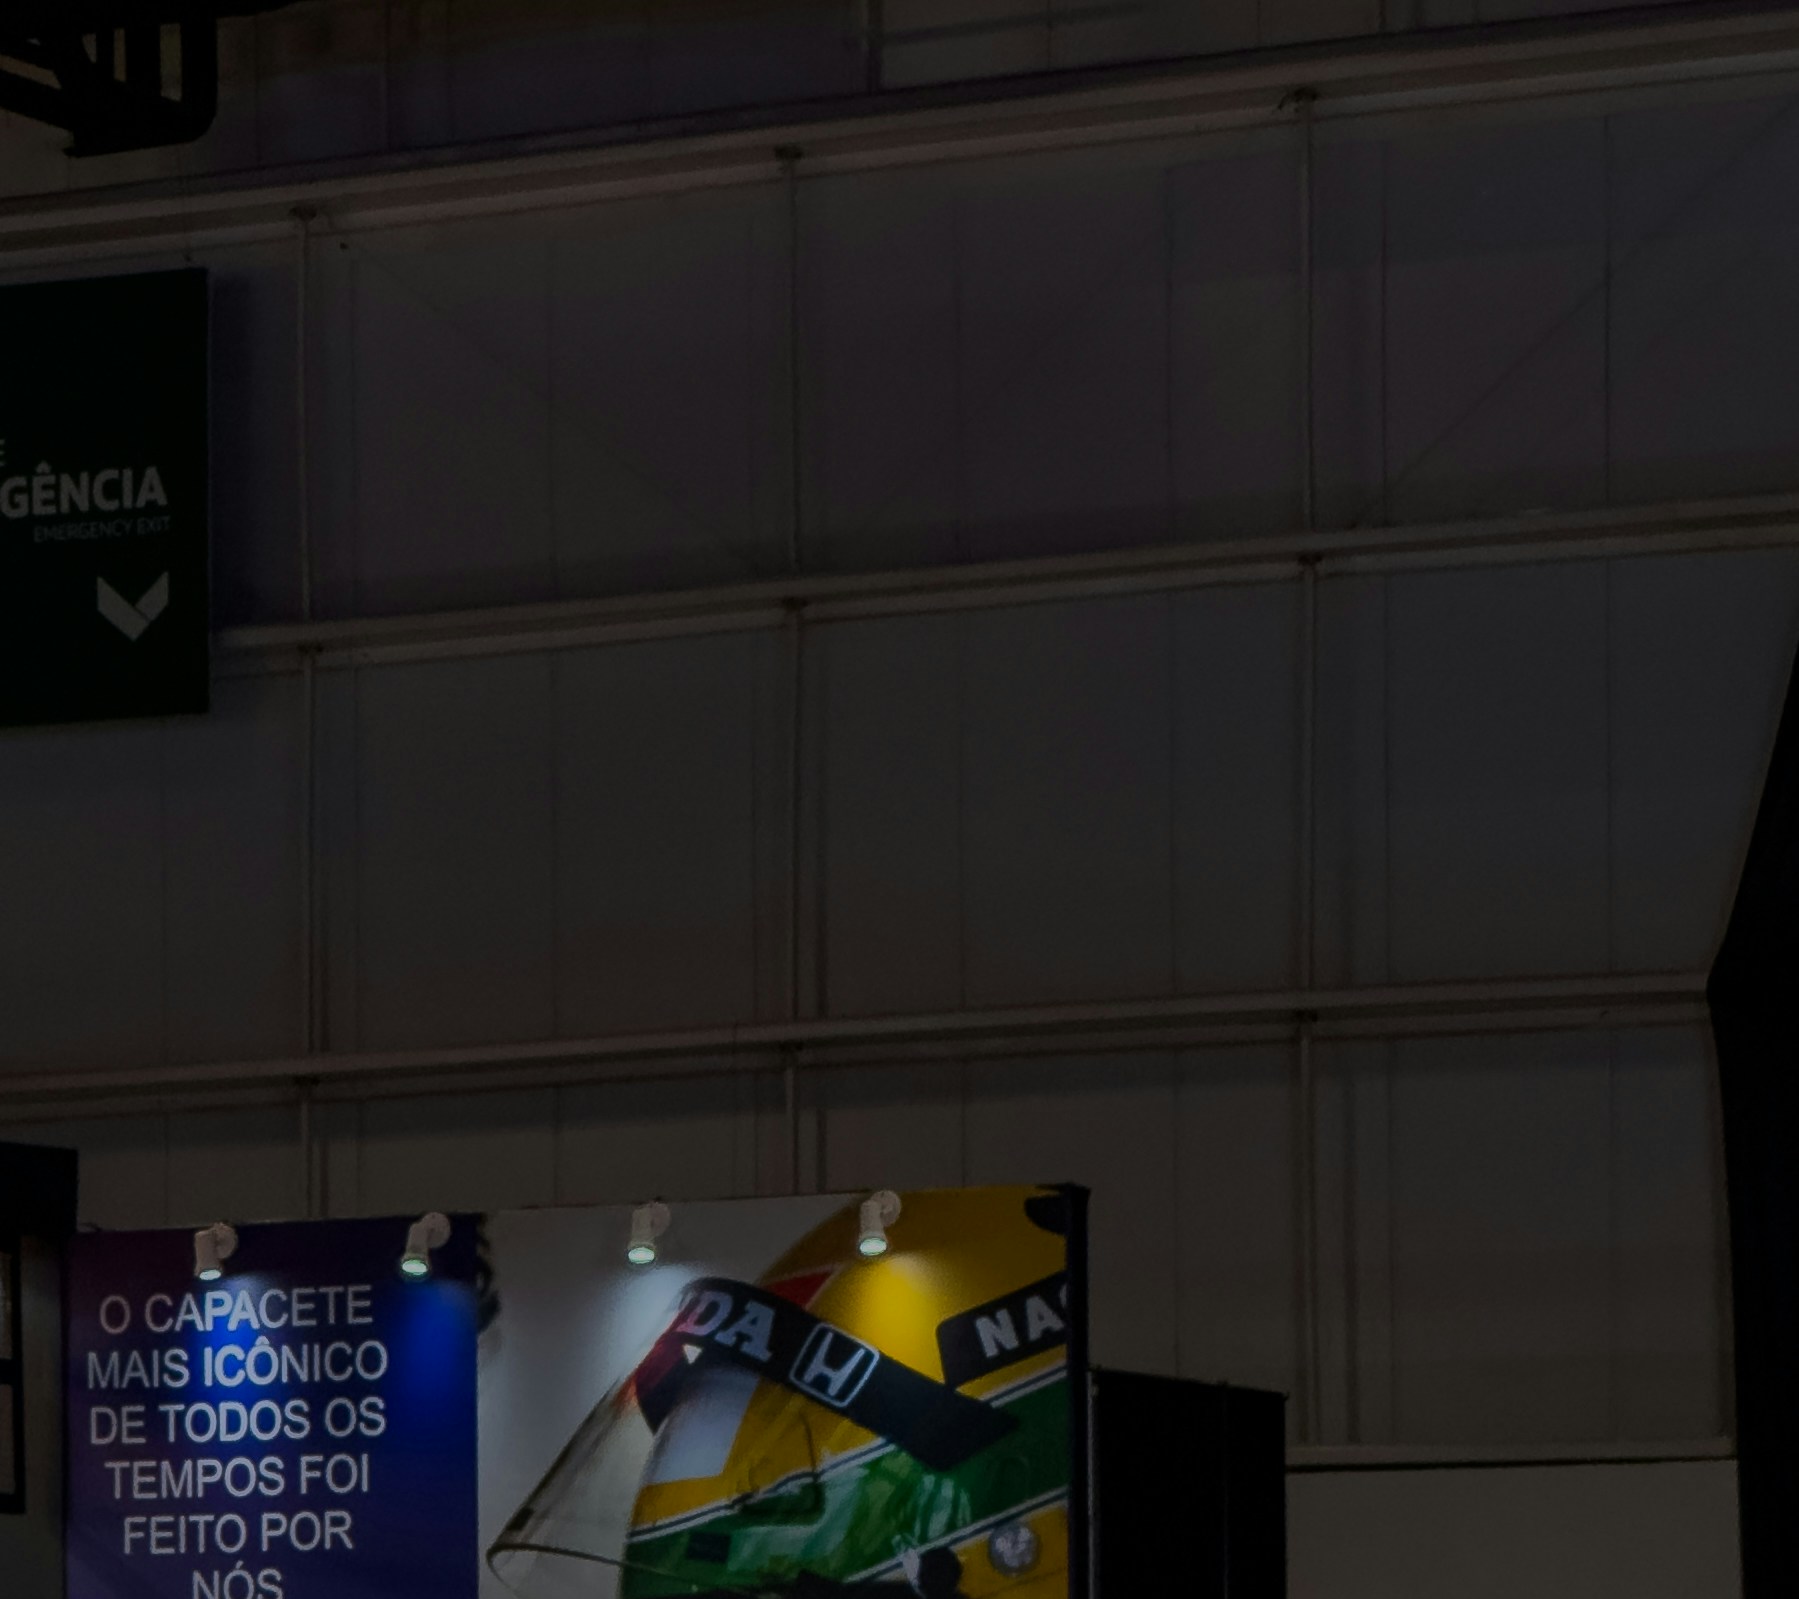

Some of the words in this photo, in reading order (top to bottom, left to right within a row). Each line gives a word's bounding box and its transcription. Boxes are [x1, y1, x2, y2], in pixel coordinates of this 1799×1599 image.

[0, 459, 168, 519] GÊNCIA
[33, 518, 133, 543] EMERGENCY
[136, 515, 171, 536] EXIT
[100, 1294, 131, 1335] O
[145, 1284, 373, 1334] CAPACETE
[975, 1282, 1068, 1359] NA
[87, 1347, 190, 1389] MAIS
[204, 1335, 389, 1388] ICÔNICO
[90, 1405, 146, 1445] DE
[159, 1400, 310, 1443] TODOS
[324, 1396, 387, 1438] OS
[104, 1456, 285, 1499] TEMPOS
[300, 1453, 370, 1494] FOI
[123, 1513, 247, 1555] FEITO
[261, 1509, 353, 1552] POR
